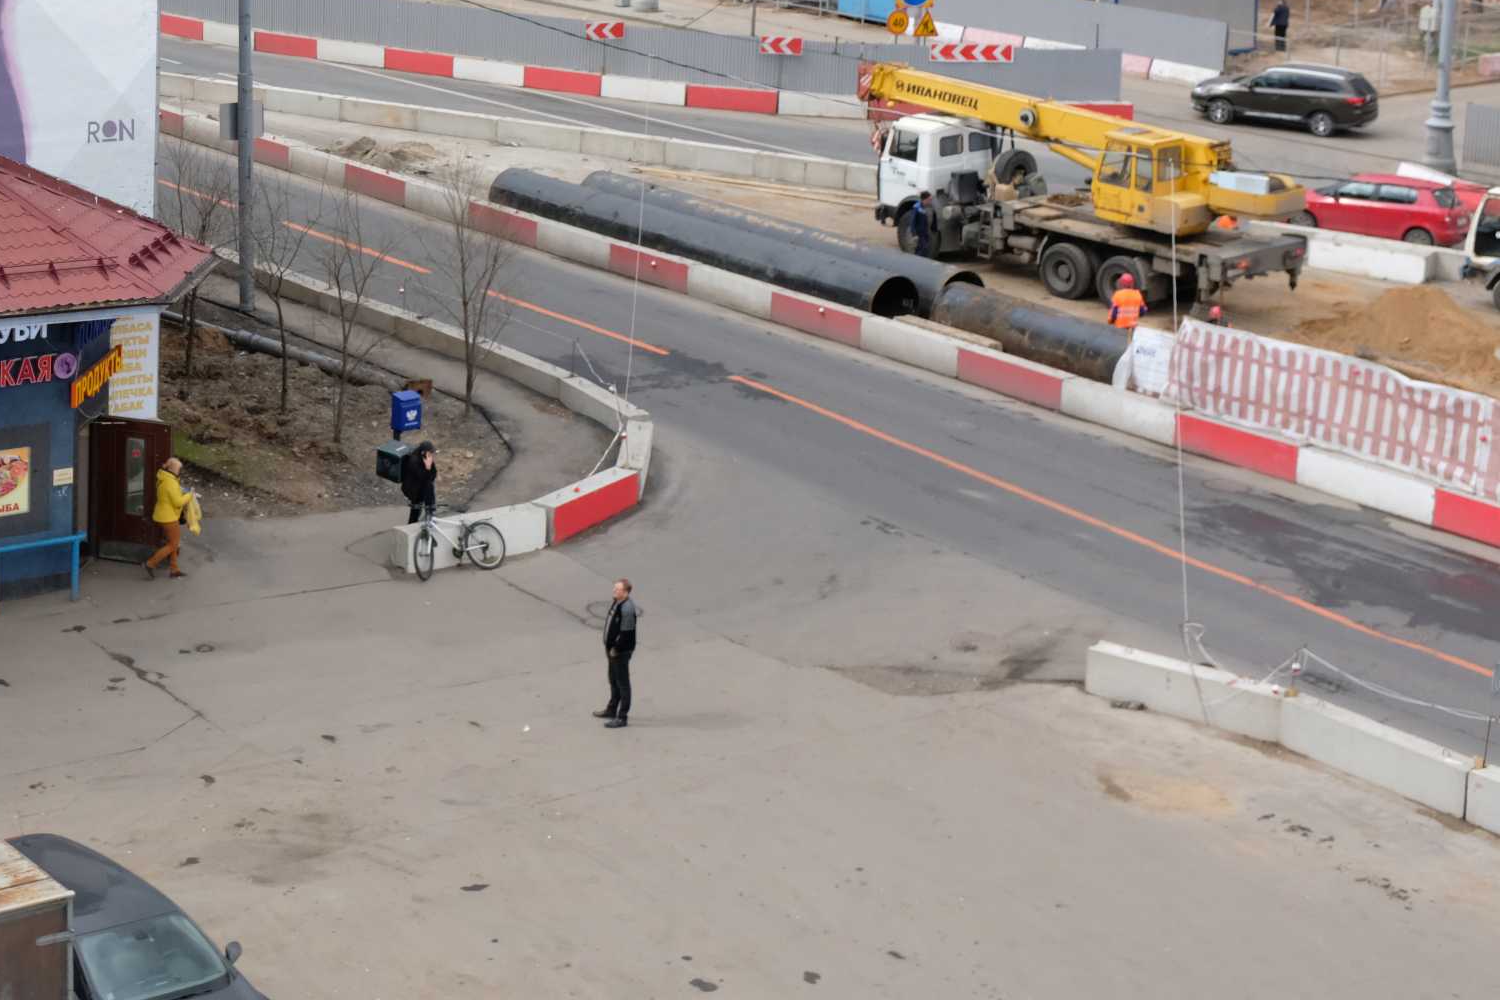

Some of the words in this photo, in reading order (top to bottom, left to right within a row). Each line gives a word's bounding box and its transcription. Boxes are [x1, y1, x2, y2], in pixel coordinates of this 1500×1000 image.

[893, 18, 904, 27] 40
[906, 84, 979, 111] ИВАНОВЕЦ
[75, 350, 122, 405] ПРОДУКТЫ
